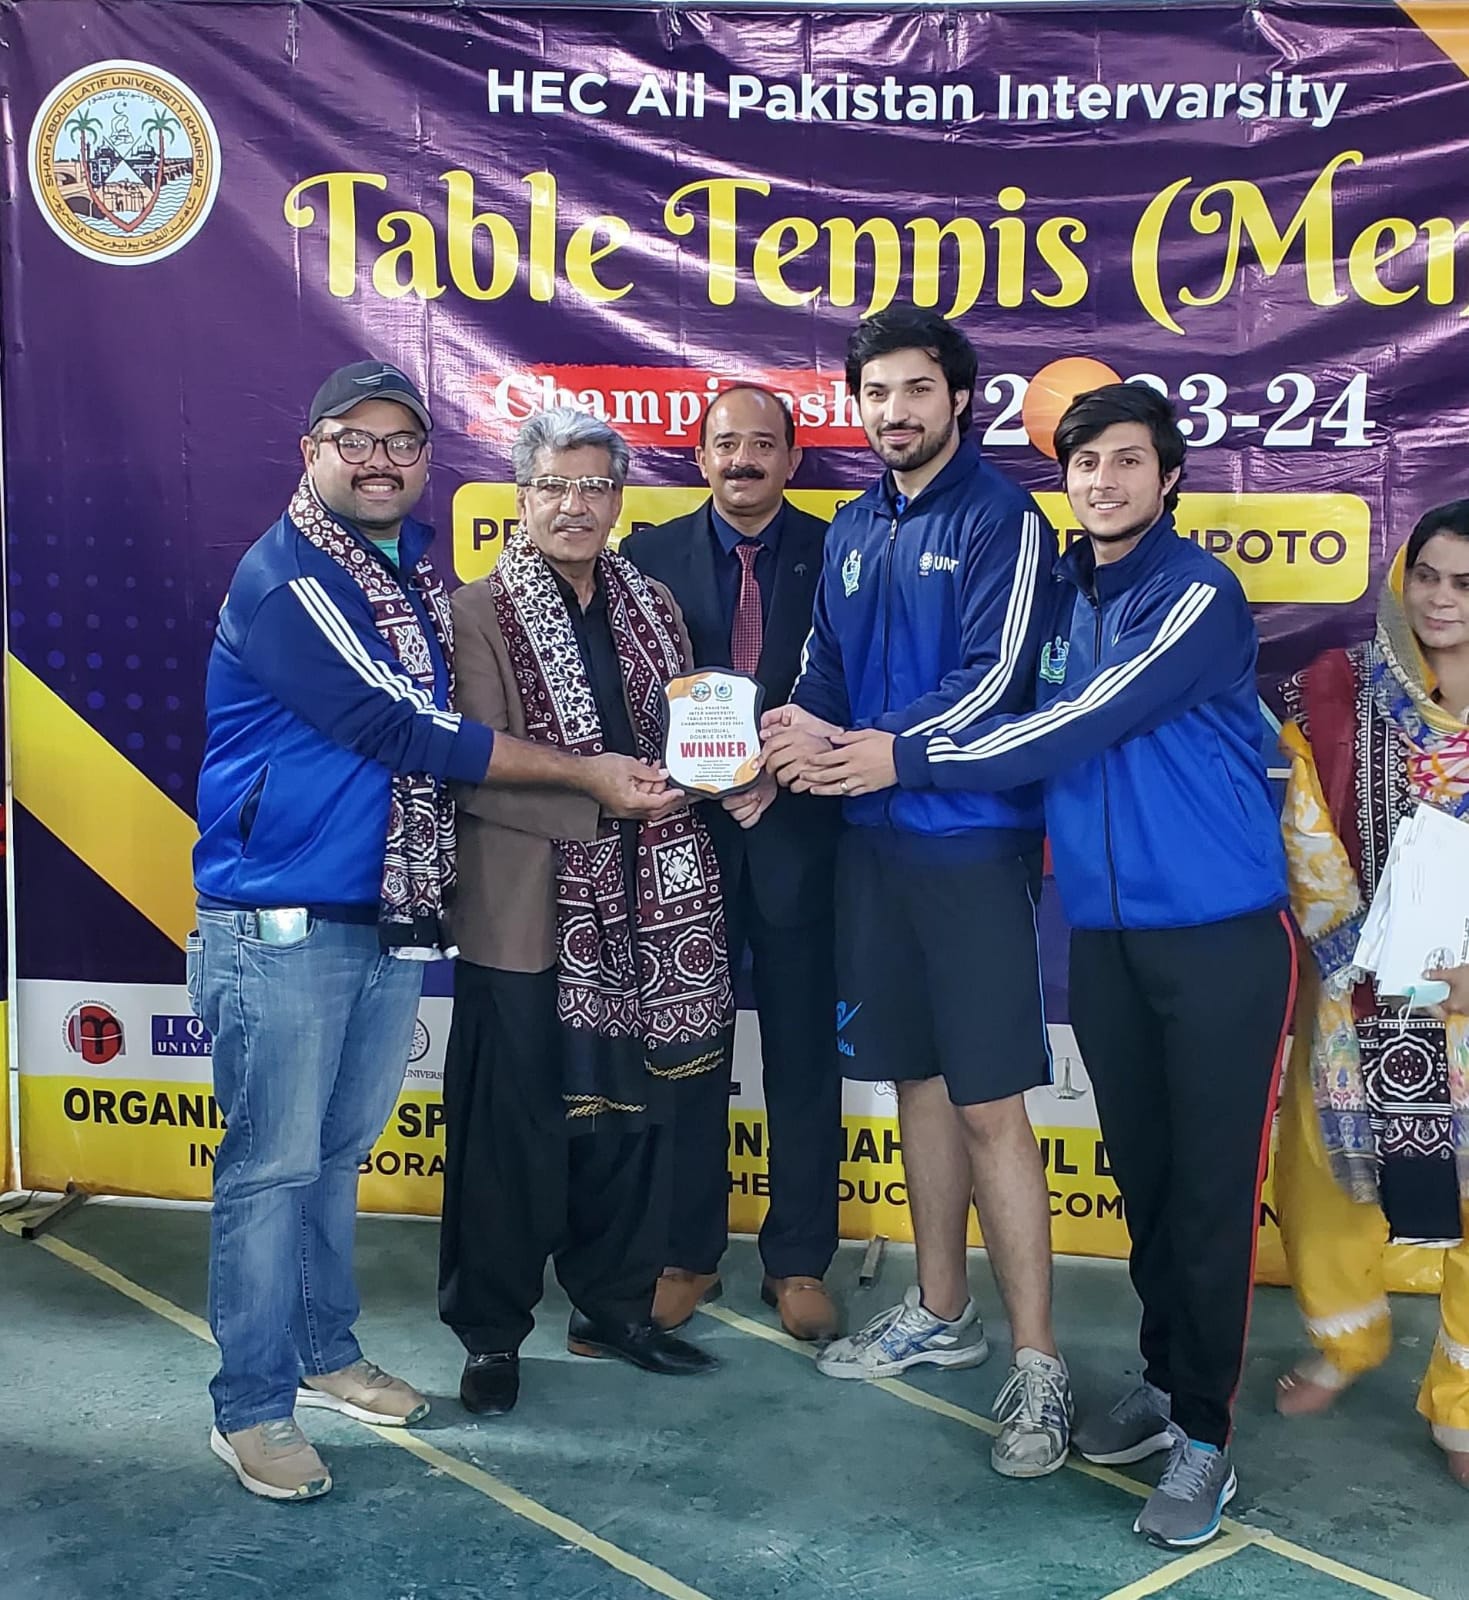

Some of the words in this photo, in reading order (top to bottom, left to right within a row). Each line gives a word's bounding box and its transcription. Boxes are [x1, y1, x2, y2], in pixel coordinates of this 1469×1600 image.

[73, 78, 108, 101] LATIF
[112, 76, 186, 114] UNIVERSITY
[488, 70, 607, 115] HEC
[628, 71, 704, 119] All
[728, 75, 975, 121] Pakistan
[999, 75, 1347, 128] Intervarsity
[46, 102, 74, 143] ABDUL
[43, 146, 54, 187] SHAH
[183, 116, 204, 188] KHAIRPUR
[284, 169, 635, 304] Table
[664, 176, 1089, 320] Tennis
[680, 742, 746, 757] WINNER
[190, 1143, 217, 1167] IN
